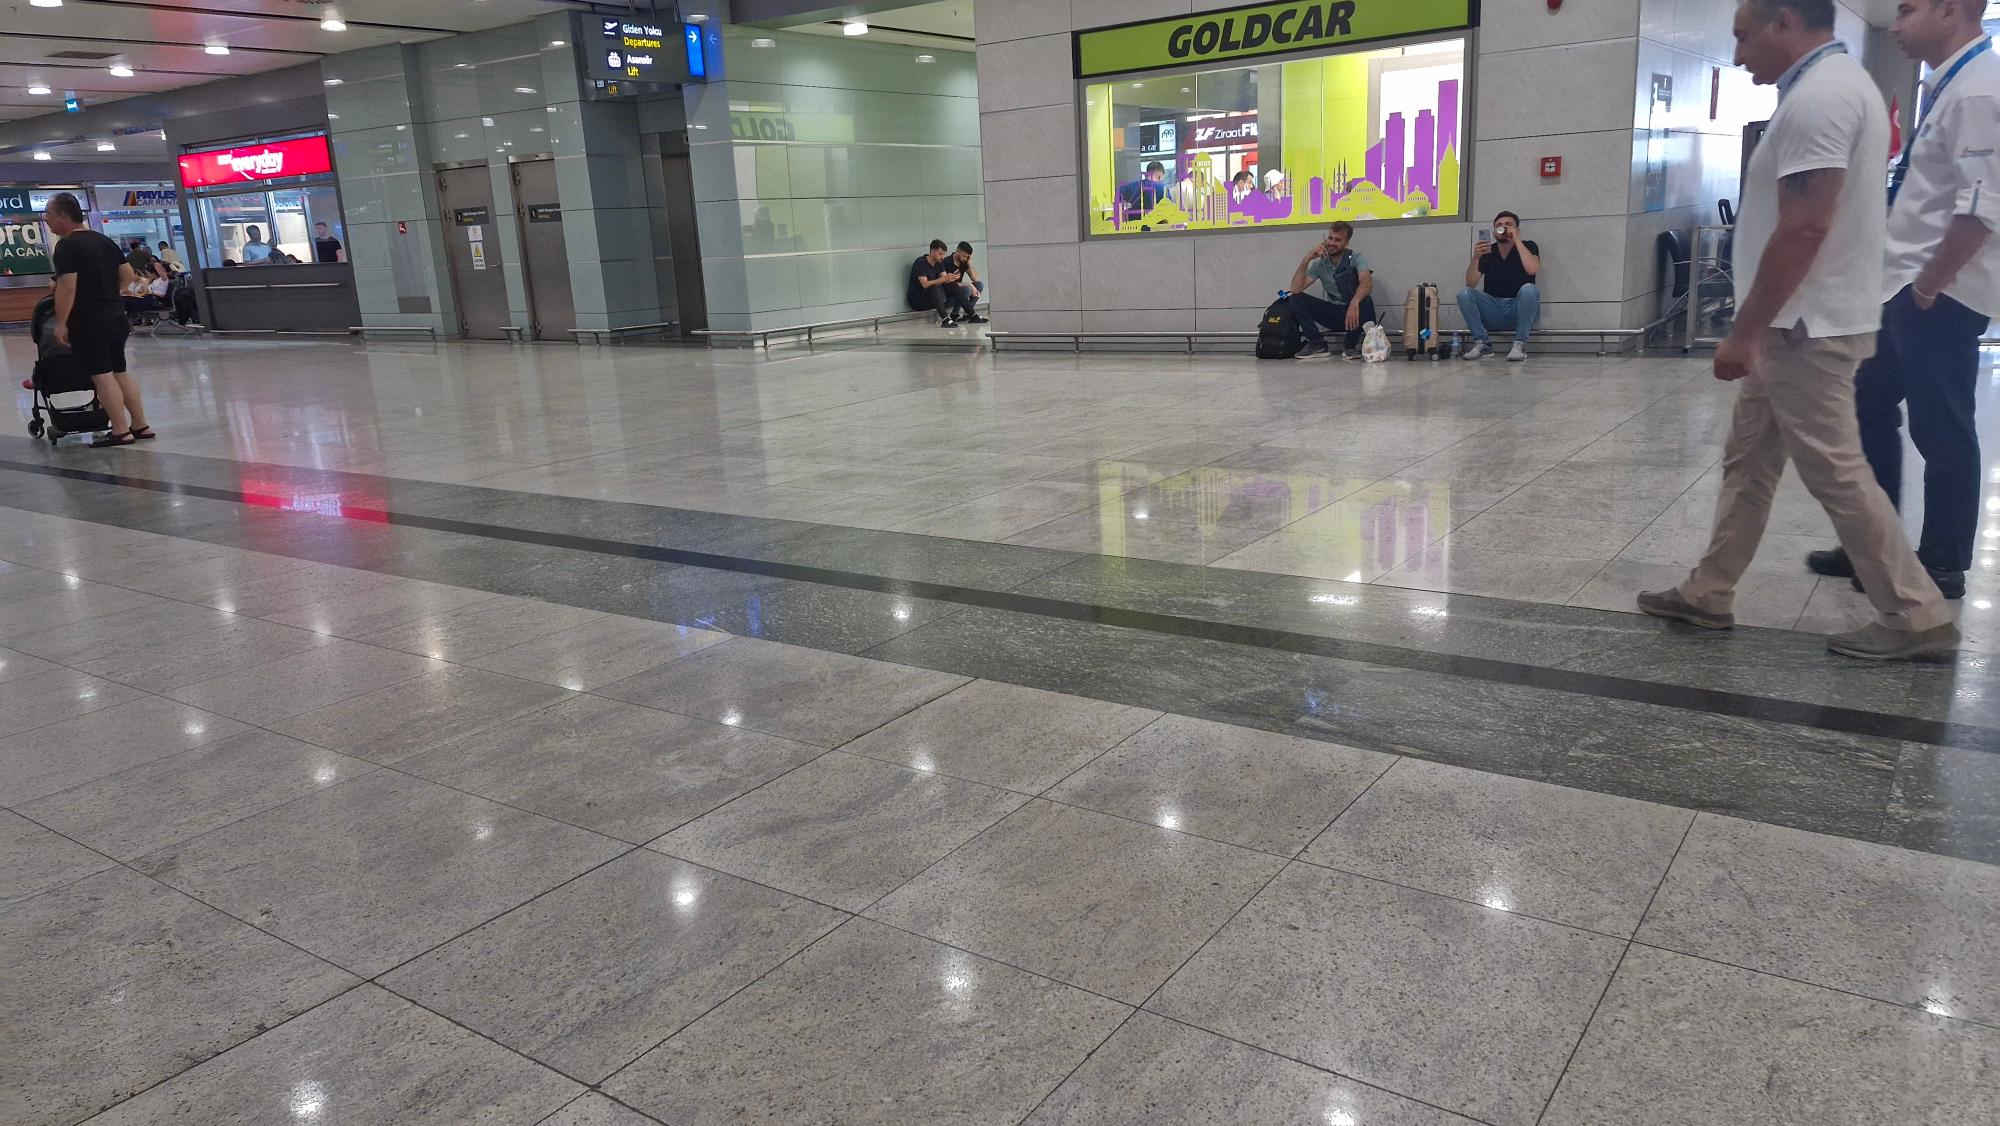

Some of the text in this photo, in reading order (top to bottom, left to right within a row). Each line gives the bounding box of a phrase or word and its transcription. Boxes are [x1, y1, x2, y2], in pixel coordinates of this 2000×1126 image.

[622, 23, 663, 36] Giden Yolcu
[1168, 0, 1356, 59] GOLDCAR
[623, 36, 661, 49] Departures
[627, 66, 640, 76] Lift
[1194, 126, 1216, 141] ZF
[1214, 128, 1242, 140] Ziraat
[0, 193, 24, 209] rd
[136, 190, 177, 199] PAYLES
[4, 248, 14, 257] A
